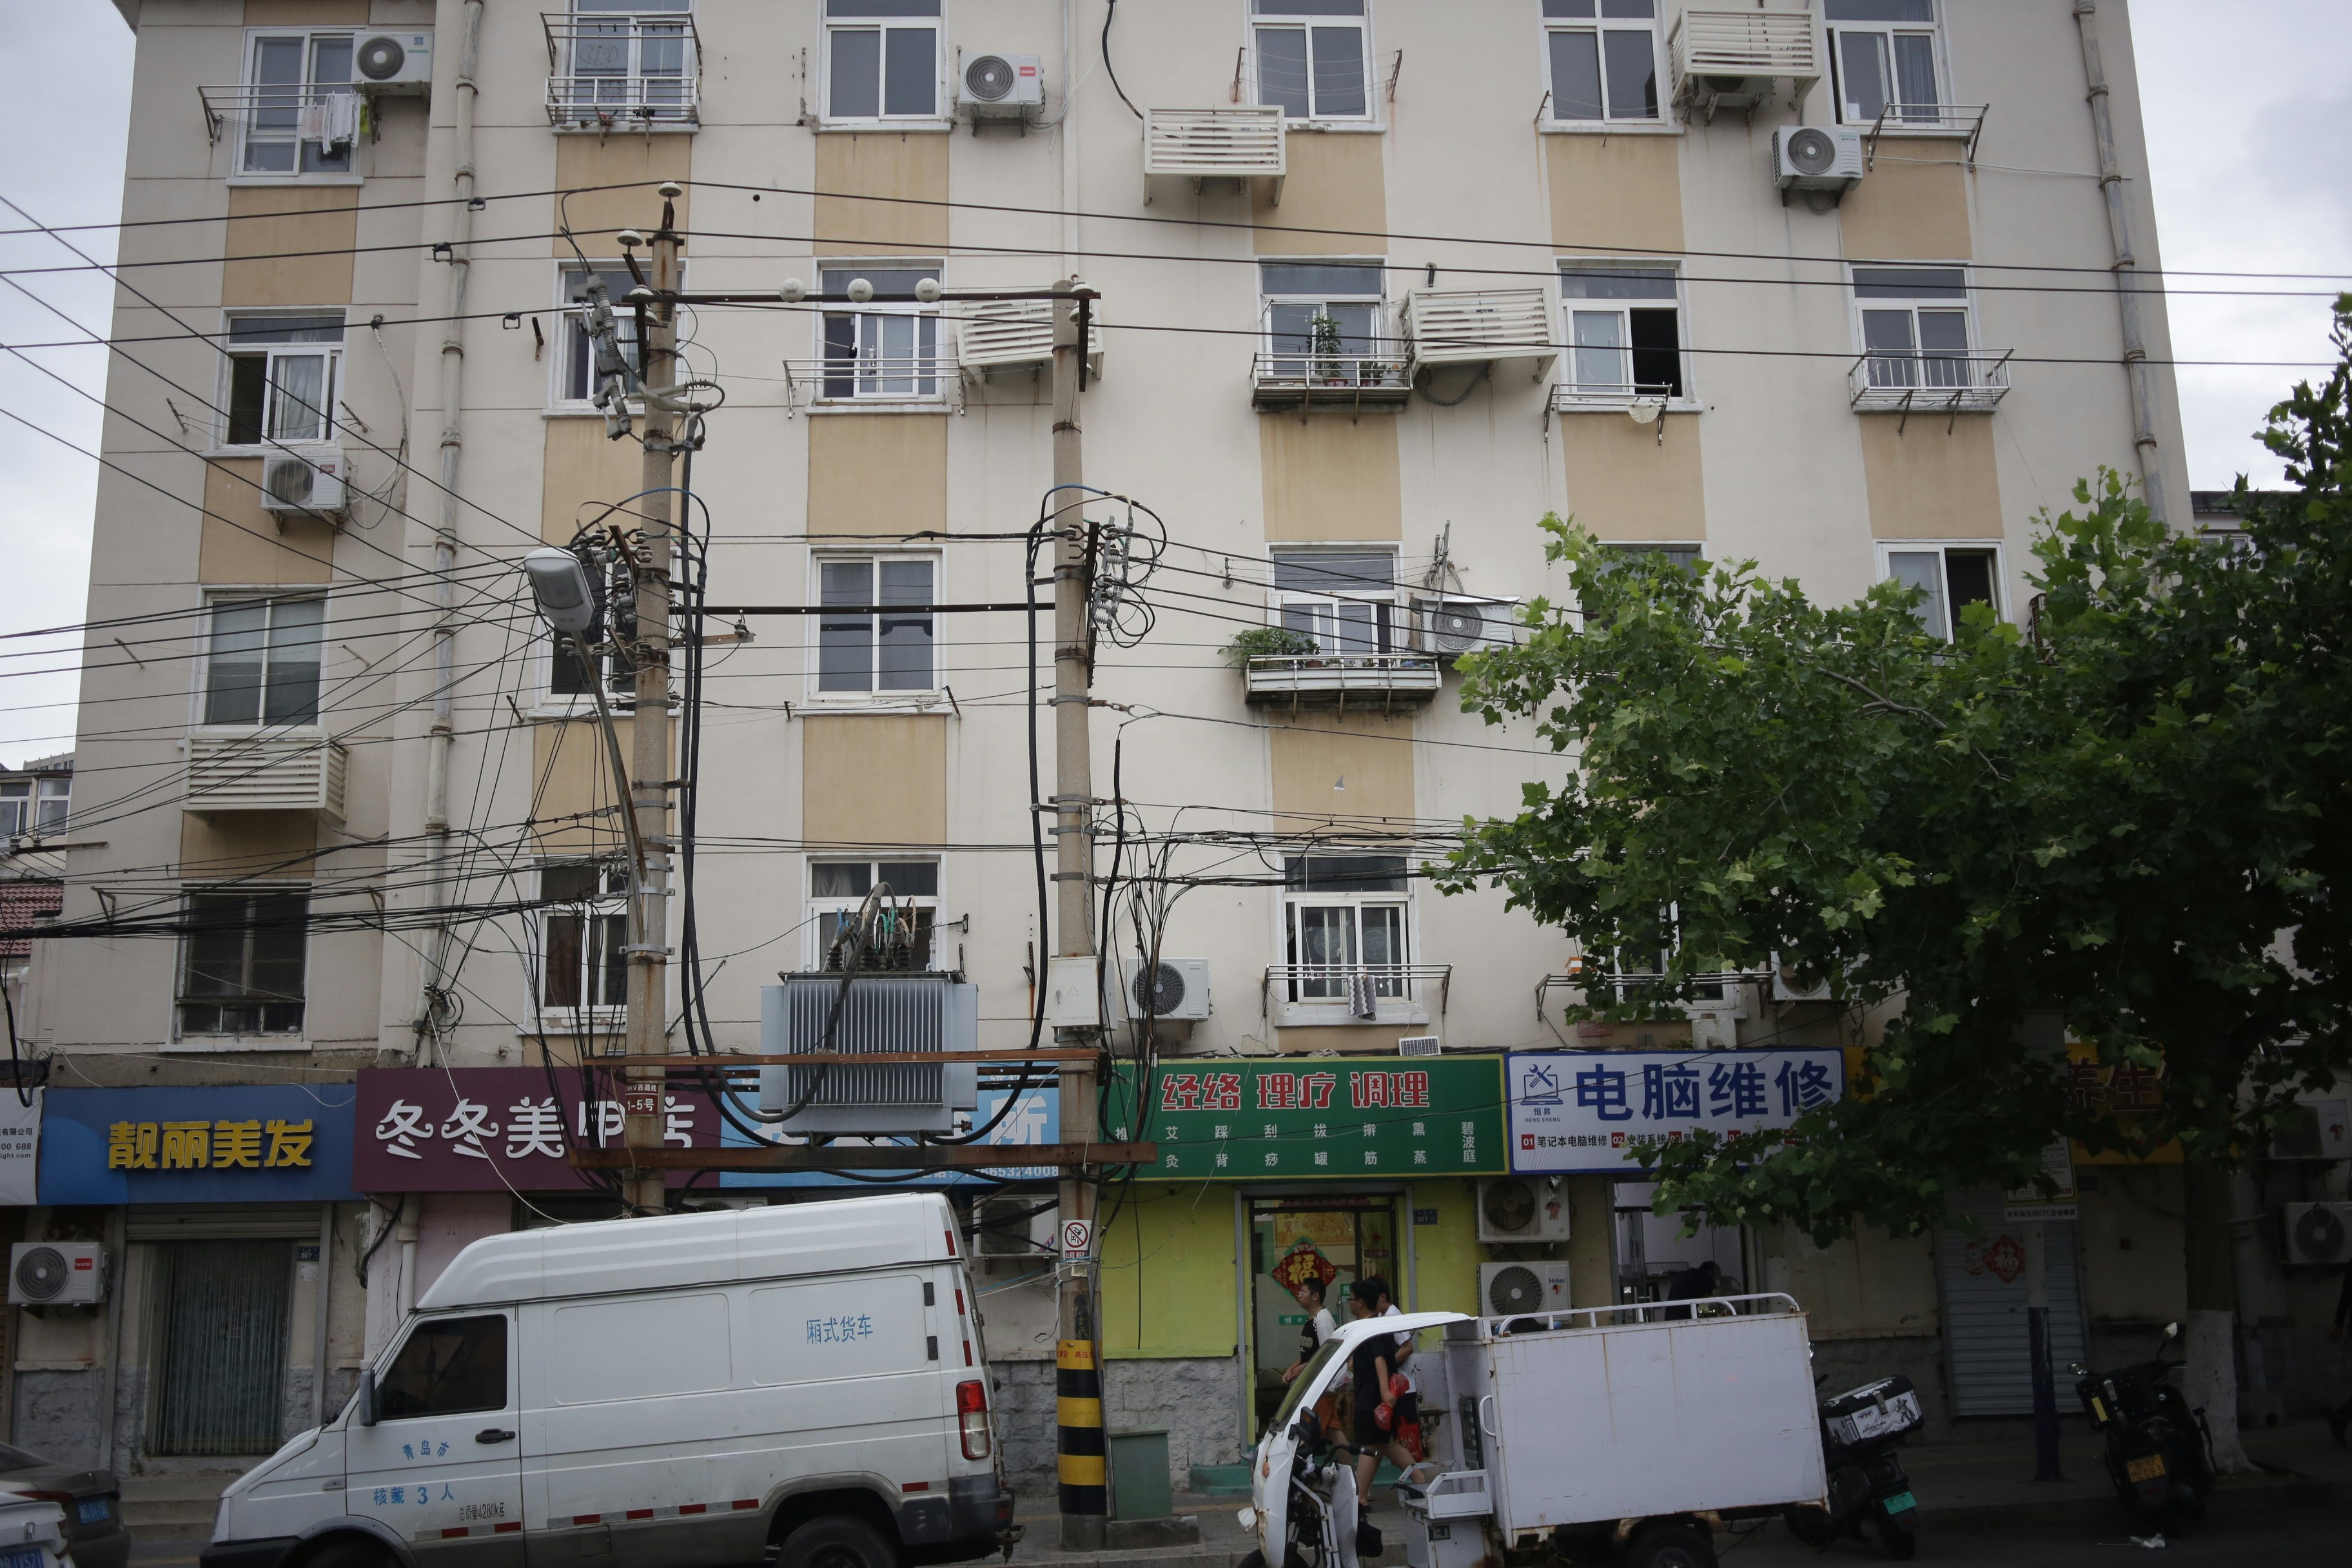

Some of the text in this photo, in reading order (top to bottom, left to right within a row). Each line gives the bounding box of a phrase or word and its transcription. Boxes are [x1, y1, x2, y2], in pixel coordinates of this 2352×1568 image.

[627, 1098, 654, 1112] 1-5号
[1161, 1070, 1430, 1111] 经络 理疗 调理
[1576, 1060, 1834, 1121] 电脑维修
[108, 1120, 313, 1169] 靓丽美发
[1166, 1126, 1179, 1168] 艾灸
[1215, 1124, 1228, 1168] 踩背
[1264, 1124, 1278, 1166] 刮痧
[1314, 1123, 1328, 1166] 拔罐
[1413, 1121, 1427, 1164] 熏蒸
[1461, 1121, 1476, 1163] 碧波庭
[1537, 1135, 1607, 1147] 笔记本电脑维修
[1627, 1133, 1666, 1146] 安装系统
[807, 1314, 873, 1344] 厢式货车
[402, 1440, 449, 1460] 青岛市
